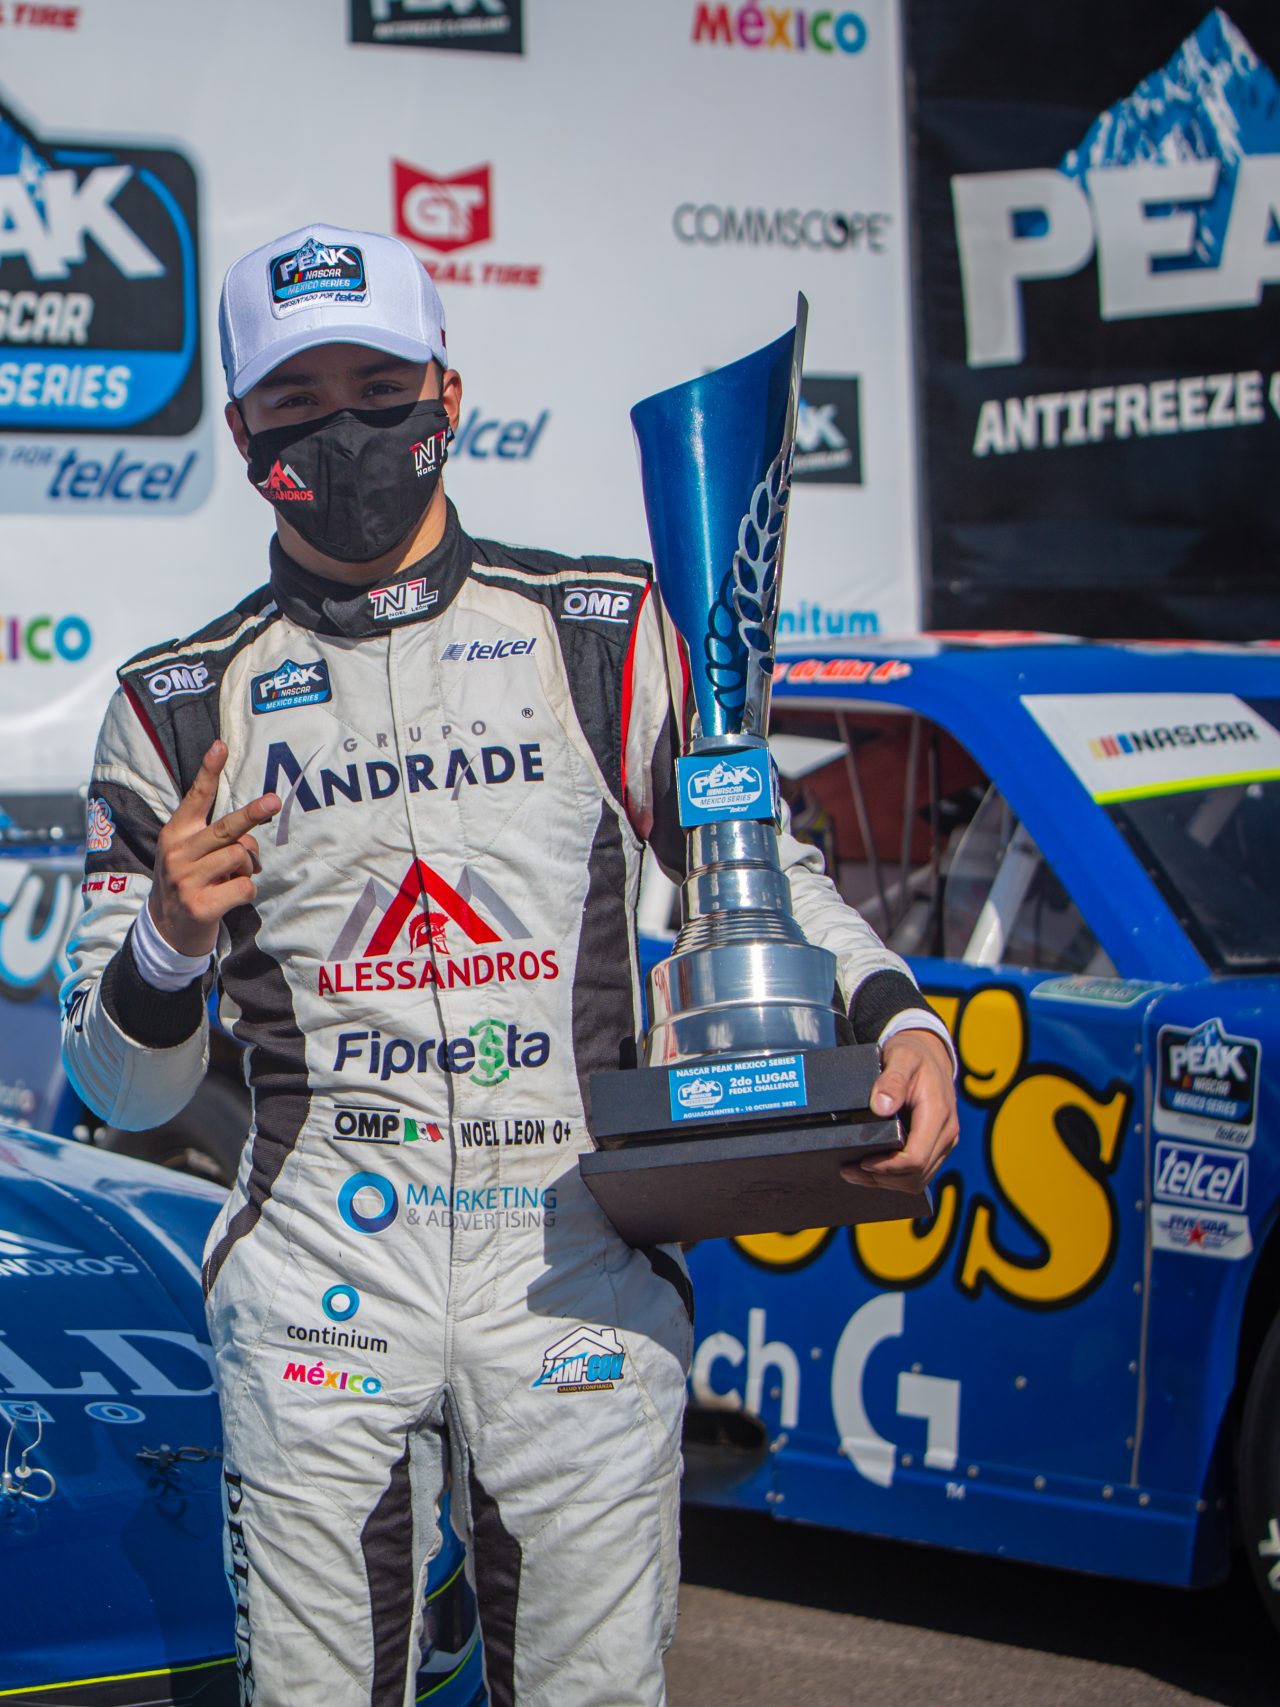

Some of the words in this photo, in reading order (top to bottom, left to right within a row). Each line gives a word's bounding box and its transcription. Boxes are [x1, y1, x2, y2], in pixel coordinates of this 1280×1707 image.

[692, 2, 867, 54] México
[401, 182, 485, 241] GT
[674, 203, 888, 253] COMMSCOPE
[280, 248, 357, 282] PEAK
[305, 269, 342, 280] NASCAR
[288, 281, 319, 295] MEXICO
[320, 279, 351, 288] SERIES
[335, 292, 367, 303] telcel
[973, 372, 1262, 457] ANTIFREEZE
[453, 407, 550, 460] lcel
[11, 445, 56, 466] POR
[45, 447, 199, 501] telcel
[417, 465, 437, 477] NOEL
[389, 610, 407, 618] NOEL
[564, 590, 631, 616] OMP
[778, 601, 880, 636] nitum
[466, 637, 537, 662] telcel
[148, 664, 210, 697] OMP
[260, 666, 324, 699] PEAK
[281, 686, 312, 697] NASCAR
[266, 698, 293, 710] MEXICO
[293, 694, 320, 704] SERIES
[343, 720, 487, 753] GRUPO
[1130, 721, 1261, 752] NASCAR
[261, 740, 545, 825] ANDRADE
[694, 766, 757, 794] PEAK
[700, 798, 726, 806] MEXICO
[727, 794, 752, 804] SERIES
[319, 949, 560, 997] ALESSANDROS
[676, 1066, 710, 1078] NASCAR
[711, 1063, 733, 1074] PEAK
[734, 1060, 768, 1071] MEXICO
[768, 1056, 797, 1067] SERIES
[1169, 1045, 1248, 1082] PEAK
[682, 1080, 720, 1098] PEAK
[729, 1076, 753, 1088] 2do
[755, 1070, 797, 1085] LUGAR
[729, 1086, 753, 1096] FEDEX
[754, 1081, 800, 1093] CHALLENGE
[683, 1107, 735, 1119] AGUASCALIENTES
[754, 1102, 781, 1112] OCTUBRE
[335, 1111, 400, 1139] OMP
[461, 1120, 500, 1147] NOEL
[505, 1120, 545, 1147] LEON
[1215, 1125, 1250, 1145] telcel
[1157, 1149, 1244, 1202] telcel
[406, 1183, 558, 1212] MARKETING
[407, 1208, 421, 1226] &
[426, 1208, 557, 1232] ADVERTISING
[287, 1322, 389, 1354] continium
[283, 1361, 382, 1395] México
[559, 1385, 578, 1393] SALUD
[582, 1384, 614, 1392] CONFIANZA
[832, 1292, 961, 1487] G
